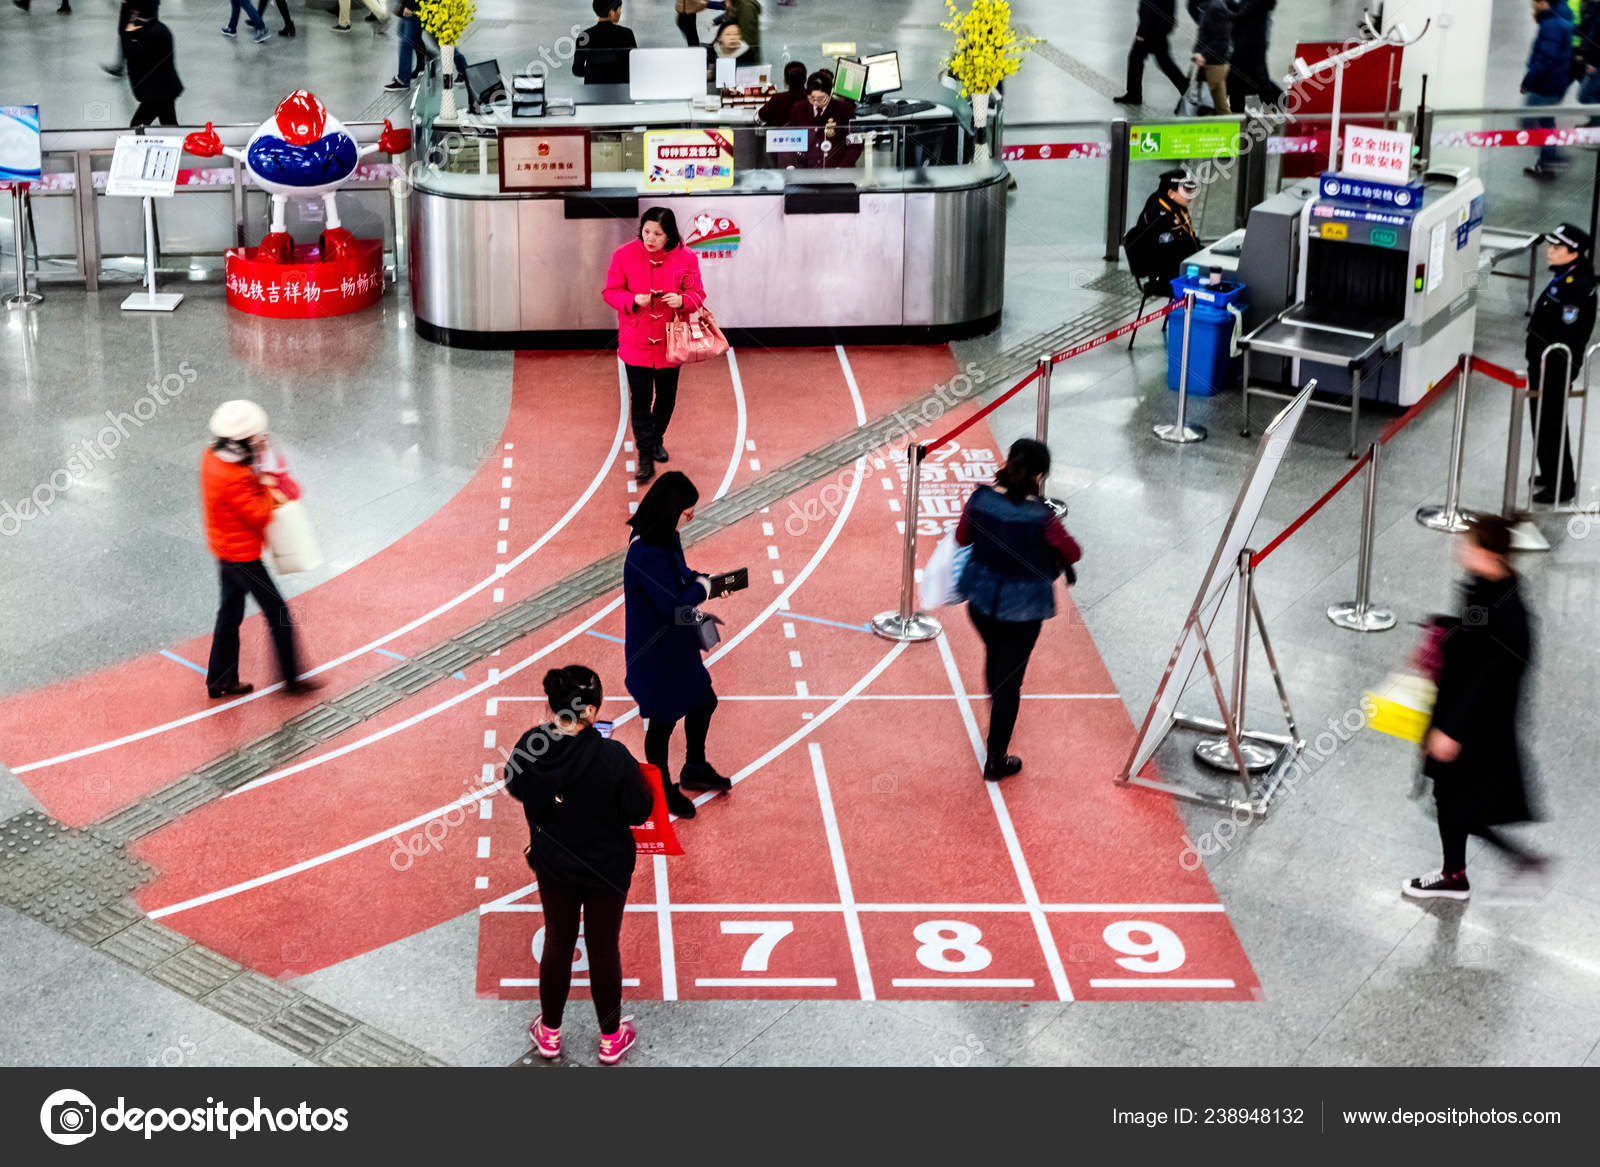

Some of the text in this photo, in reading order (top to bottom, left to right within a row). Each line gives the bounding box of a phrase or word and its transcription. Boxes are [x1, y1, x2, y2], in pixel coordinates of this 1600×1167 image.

[1351, 136, 1404, 154] 安全出行
[1351, 152, 1403, 170] 自觉安检
[1341, 184, 1394, 202] 请主动安检
[720, 919, 1186, 973] 7 8 9
